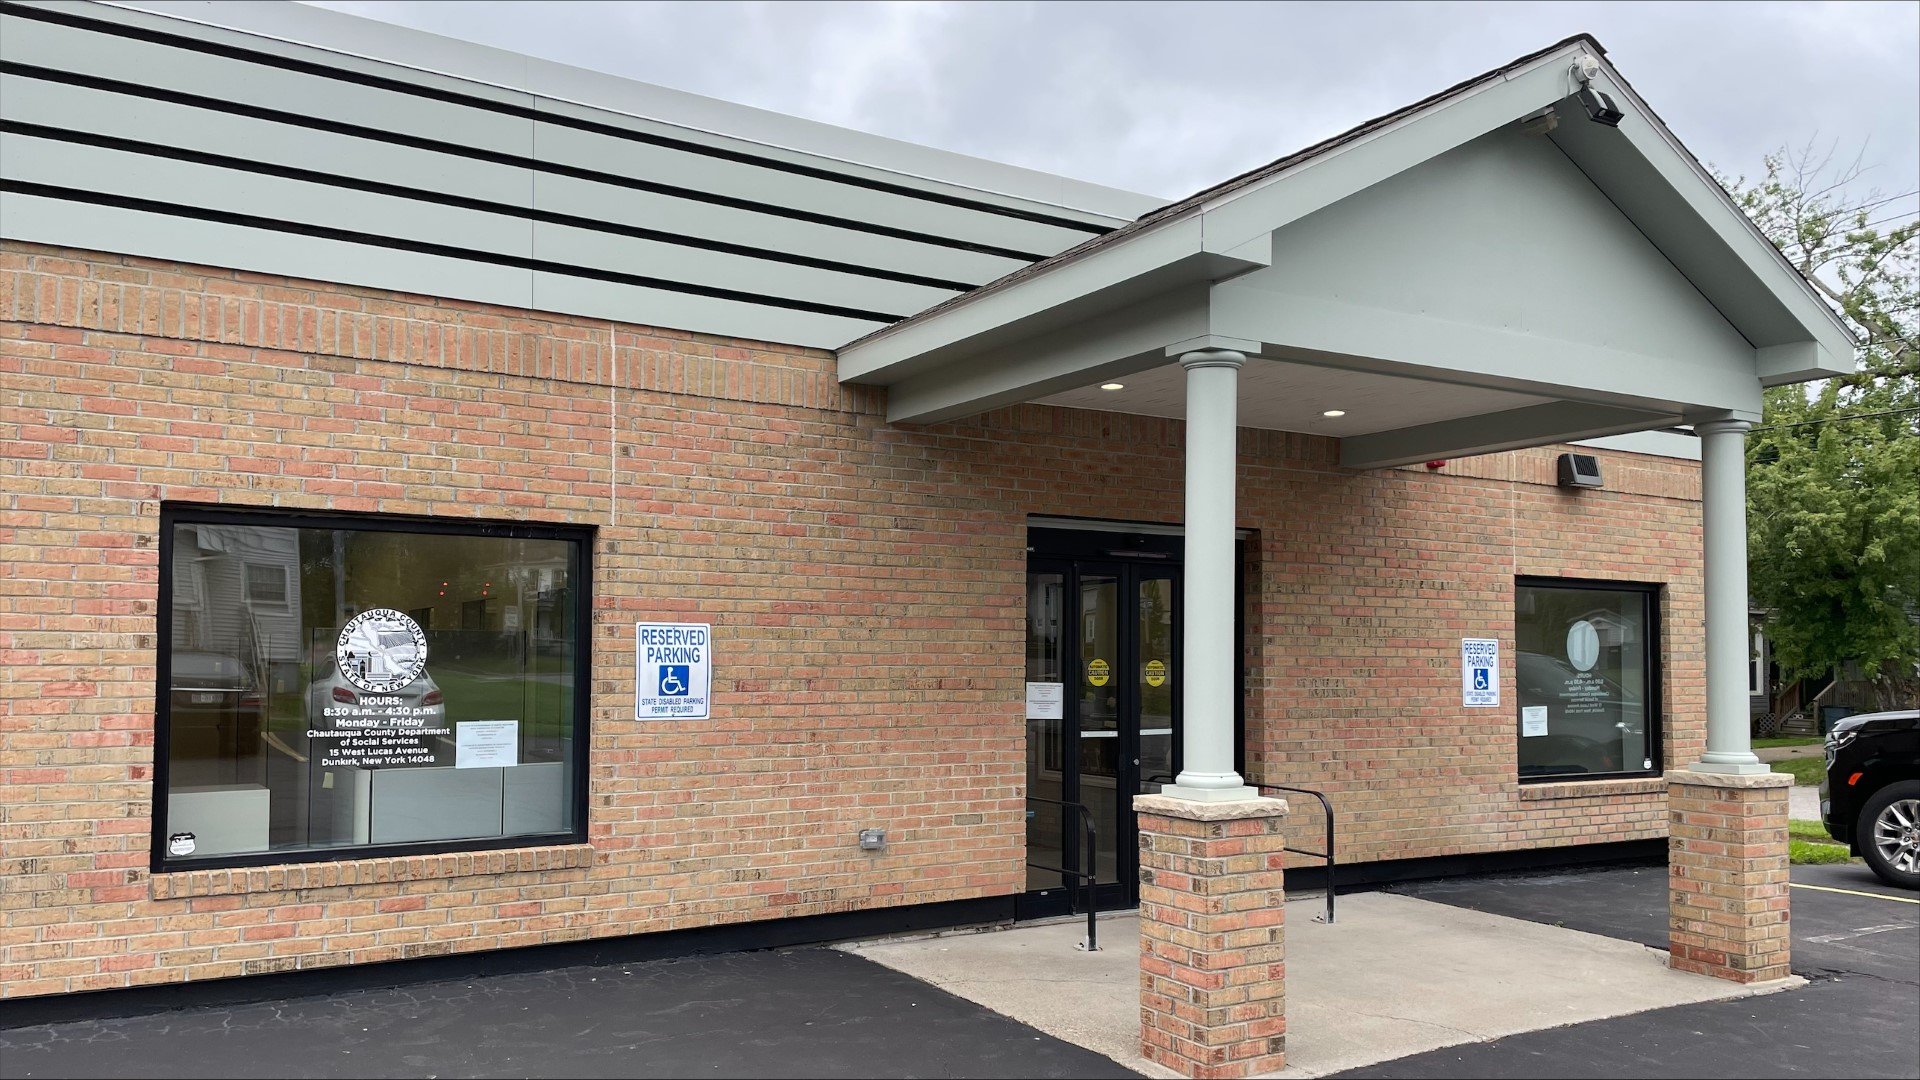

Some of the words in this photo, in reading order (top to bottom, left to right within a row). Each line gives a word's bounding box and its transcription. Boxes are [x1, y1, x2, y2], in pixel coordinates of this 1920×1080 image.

[339, 609, 396, 646] CHAUTAUQUA
[399, 614, 426, 647] COUNTY
[641, 629, 705, 646] RESERVED
[1464, 643, 1495, 655] RESERVED
[647, 647, 700, 663] PARKING
[1467, 655, 1494, 668] PARKING
[338, 655, 360, 685] STATE
[382, 681, 404, 692] NEW
[406, 657, 426, 681] YORK
[359, 696, 403, 706] HOURS:
[641, 698, 656, 706] STATE
[684, 697, 704, 705] PARKING
[323, 707, 349, 717] 8:30
[352, 708, 375, 716] a.m.
[385, 707, 411, 715] 4:30
[412, 708, 437, 717] p.m.
[651, 706, 668, 714] PERMIT
[335, 718, 380, 728] Monday
[389, 717, 425, 727] Friday
[306, 730, 361, 738] Chautauqua
[364, 729, 396, 737] County
[398, 728, 450, 737] Department
[352, 738, 379, 746] Social
[382, 737, 419, 745] Services
[341, 748, 365, 756] West
[367, 747, 393, 755] Lucas
[395, 747, 429, 755] Avenue
[321, 758, 360, 767] Dunkirk,
[362, 757, 381, 765] New
[384, 756, 405, 764] York
[407, 755, 435, 763] 14048
